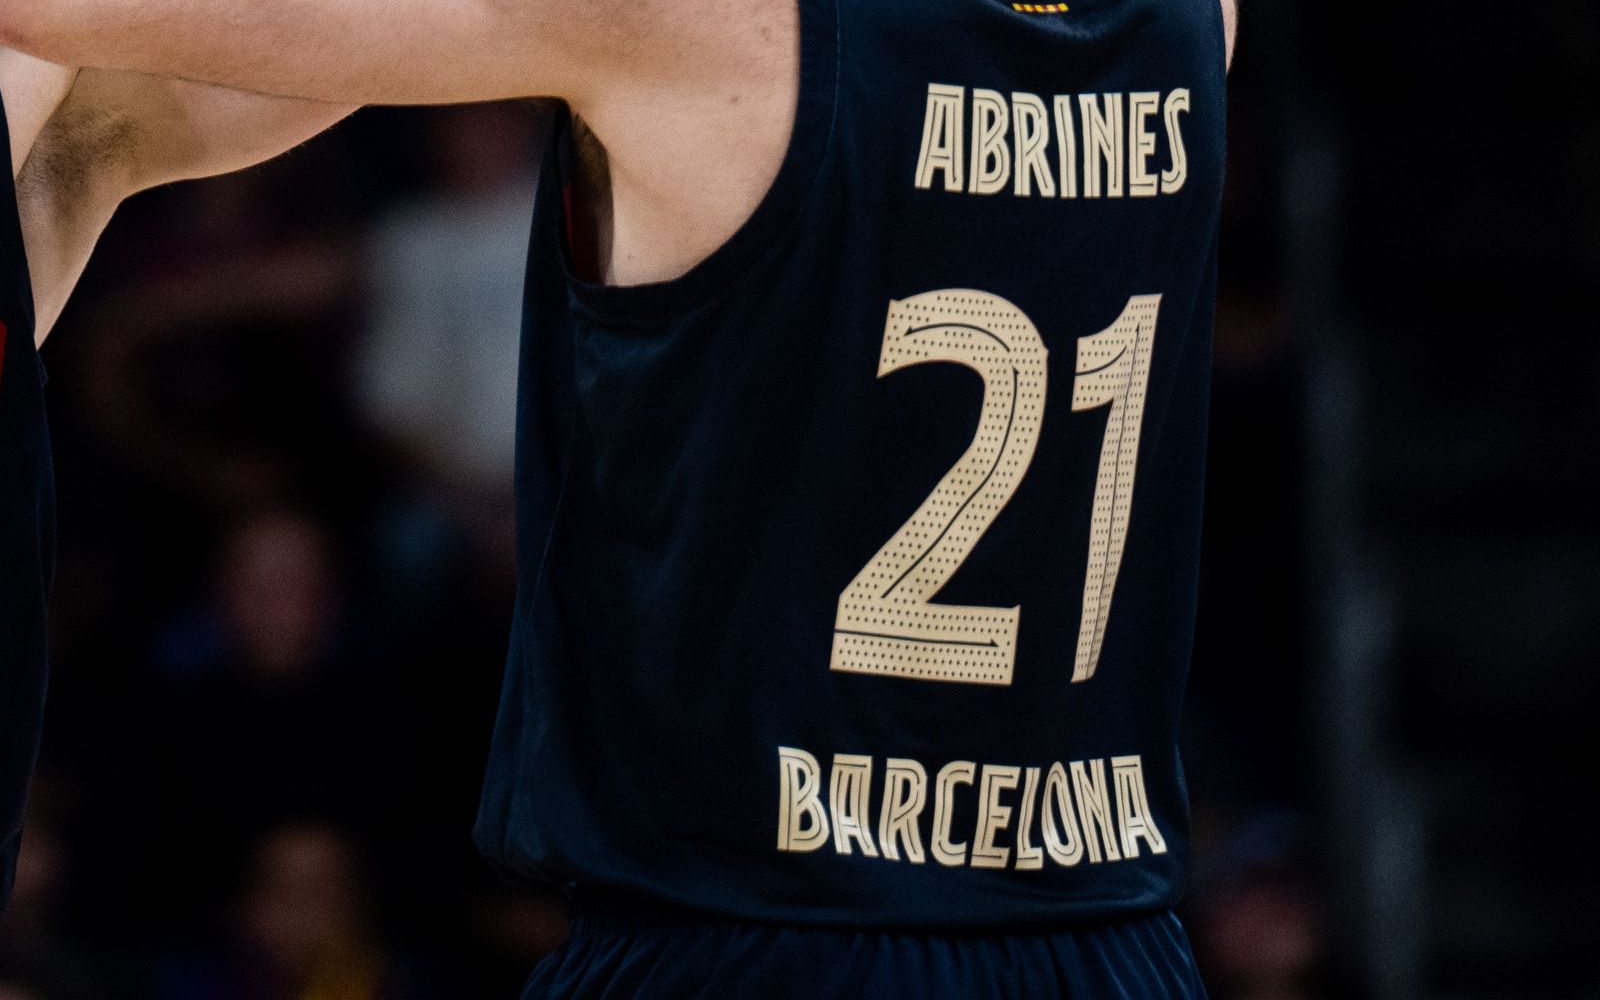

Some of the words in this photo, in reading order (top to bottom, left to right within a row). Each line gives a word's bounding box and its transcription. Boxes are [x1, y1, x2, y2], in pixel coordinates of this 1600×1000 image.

[915, 82, 1190, 198] ABRINES
[829, 288, 1162, 685] 21
[777, 746, 1168, 870] BARCELONA
